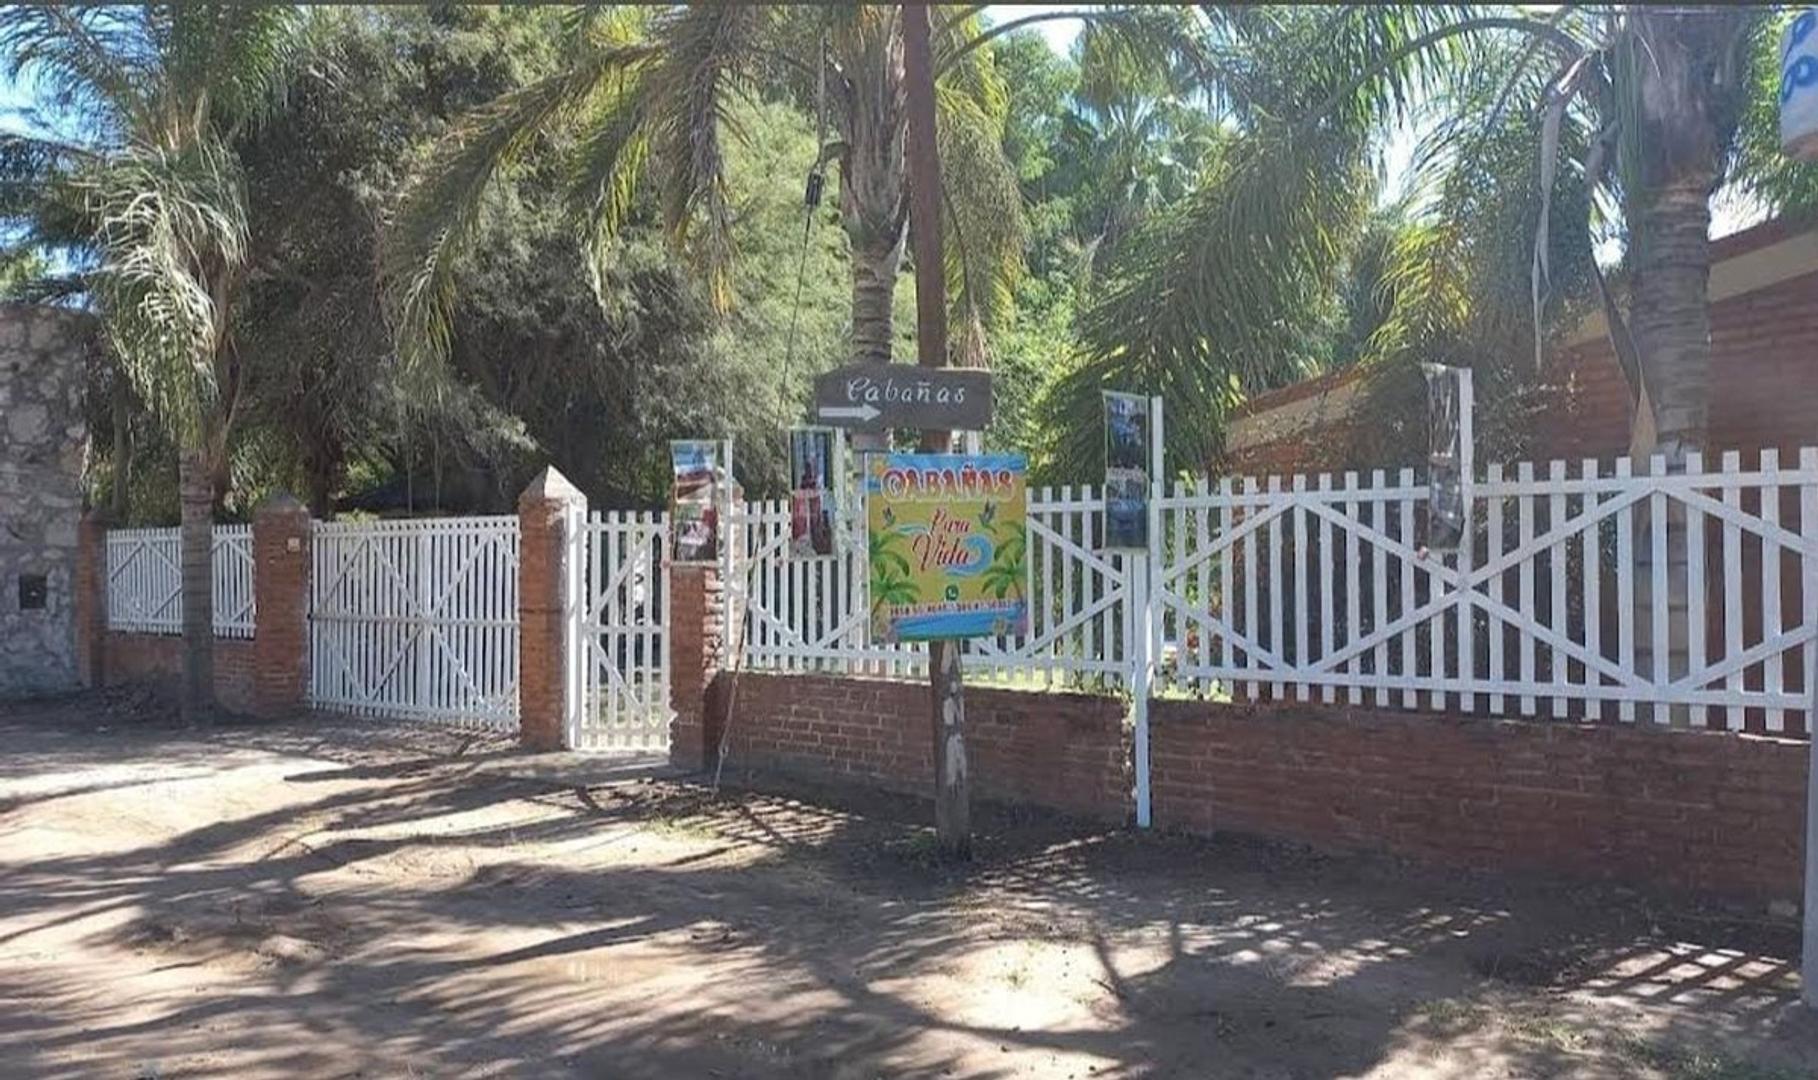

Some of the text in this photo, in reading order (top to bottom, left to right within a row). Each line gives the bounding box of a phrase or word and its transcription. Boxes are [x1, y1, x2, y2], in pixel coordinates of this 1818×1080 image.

[847, 378, 965, 403] Cabañas
[882, 463, 1013, 500] CABAÑAS
[912, 535, 969, 571] Vida
